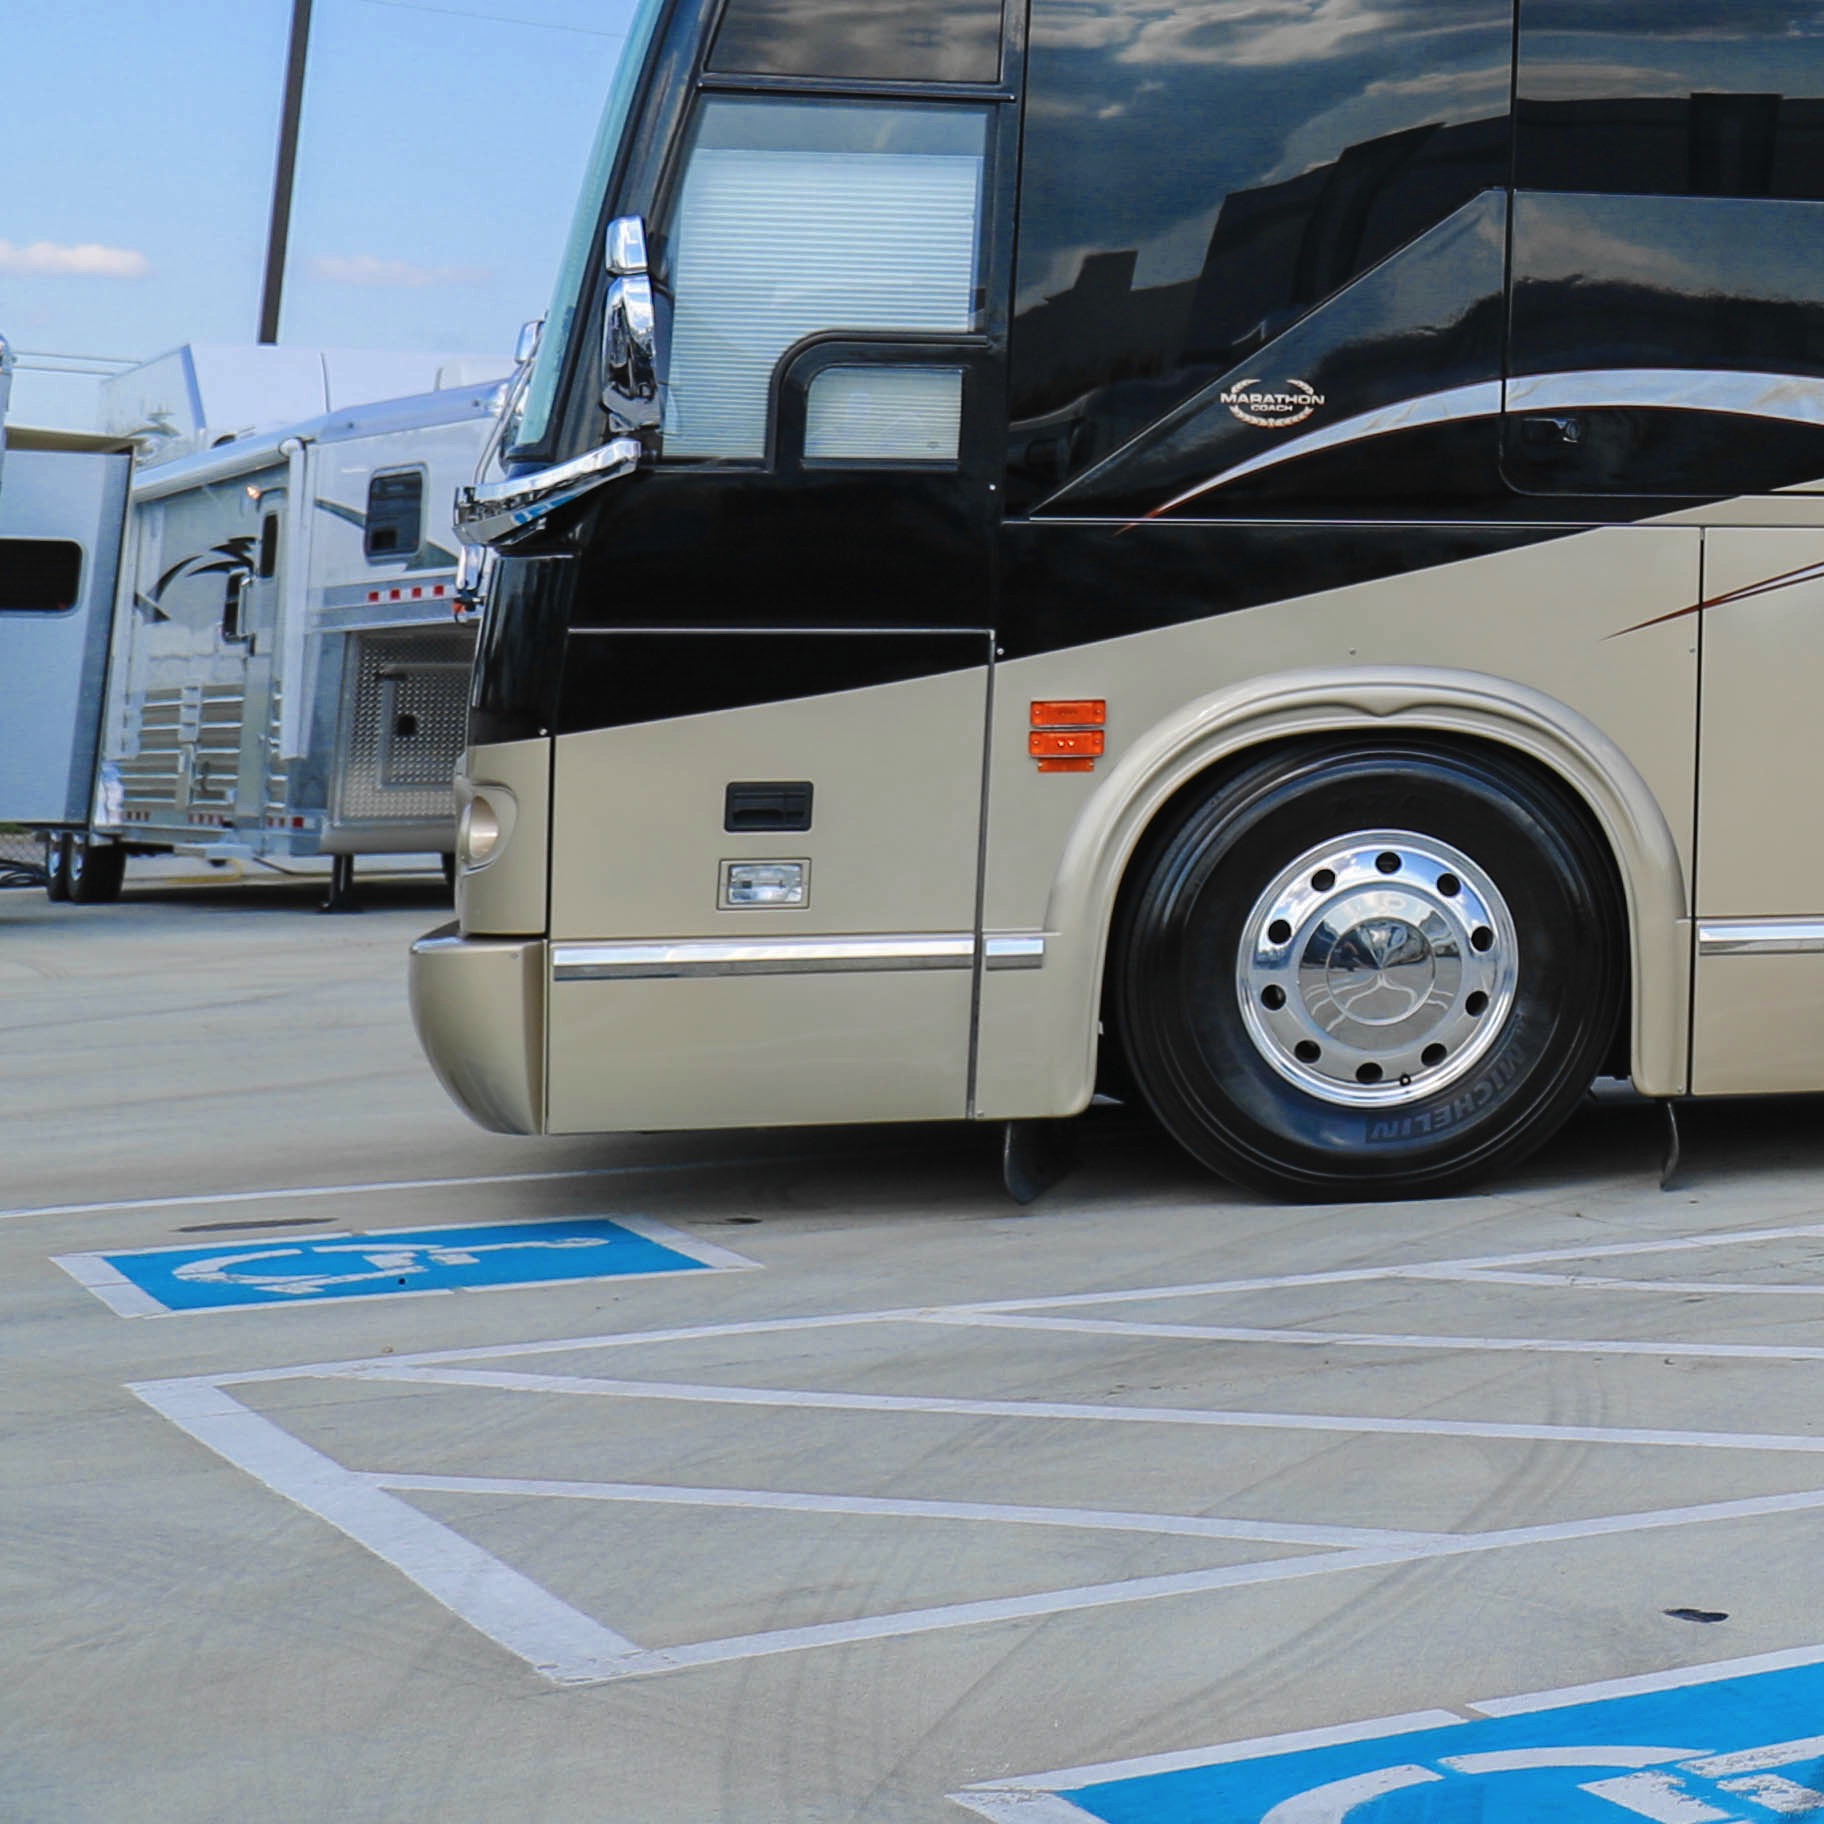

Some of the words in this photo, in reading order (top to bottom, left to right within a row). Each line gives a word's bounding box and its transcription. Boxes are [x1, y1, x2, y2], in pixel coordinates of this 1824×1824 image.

[1220, 393, 1325, 405] MARATHON
[1250, 404, 1293, 412] COACH
[1370, 1040, 1530, 1141] MICHELIN
